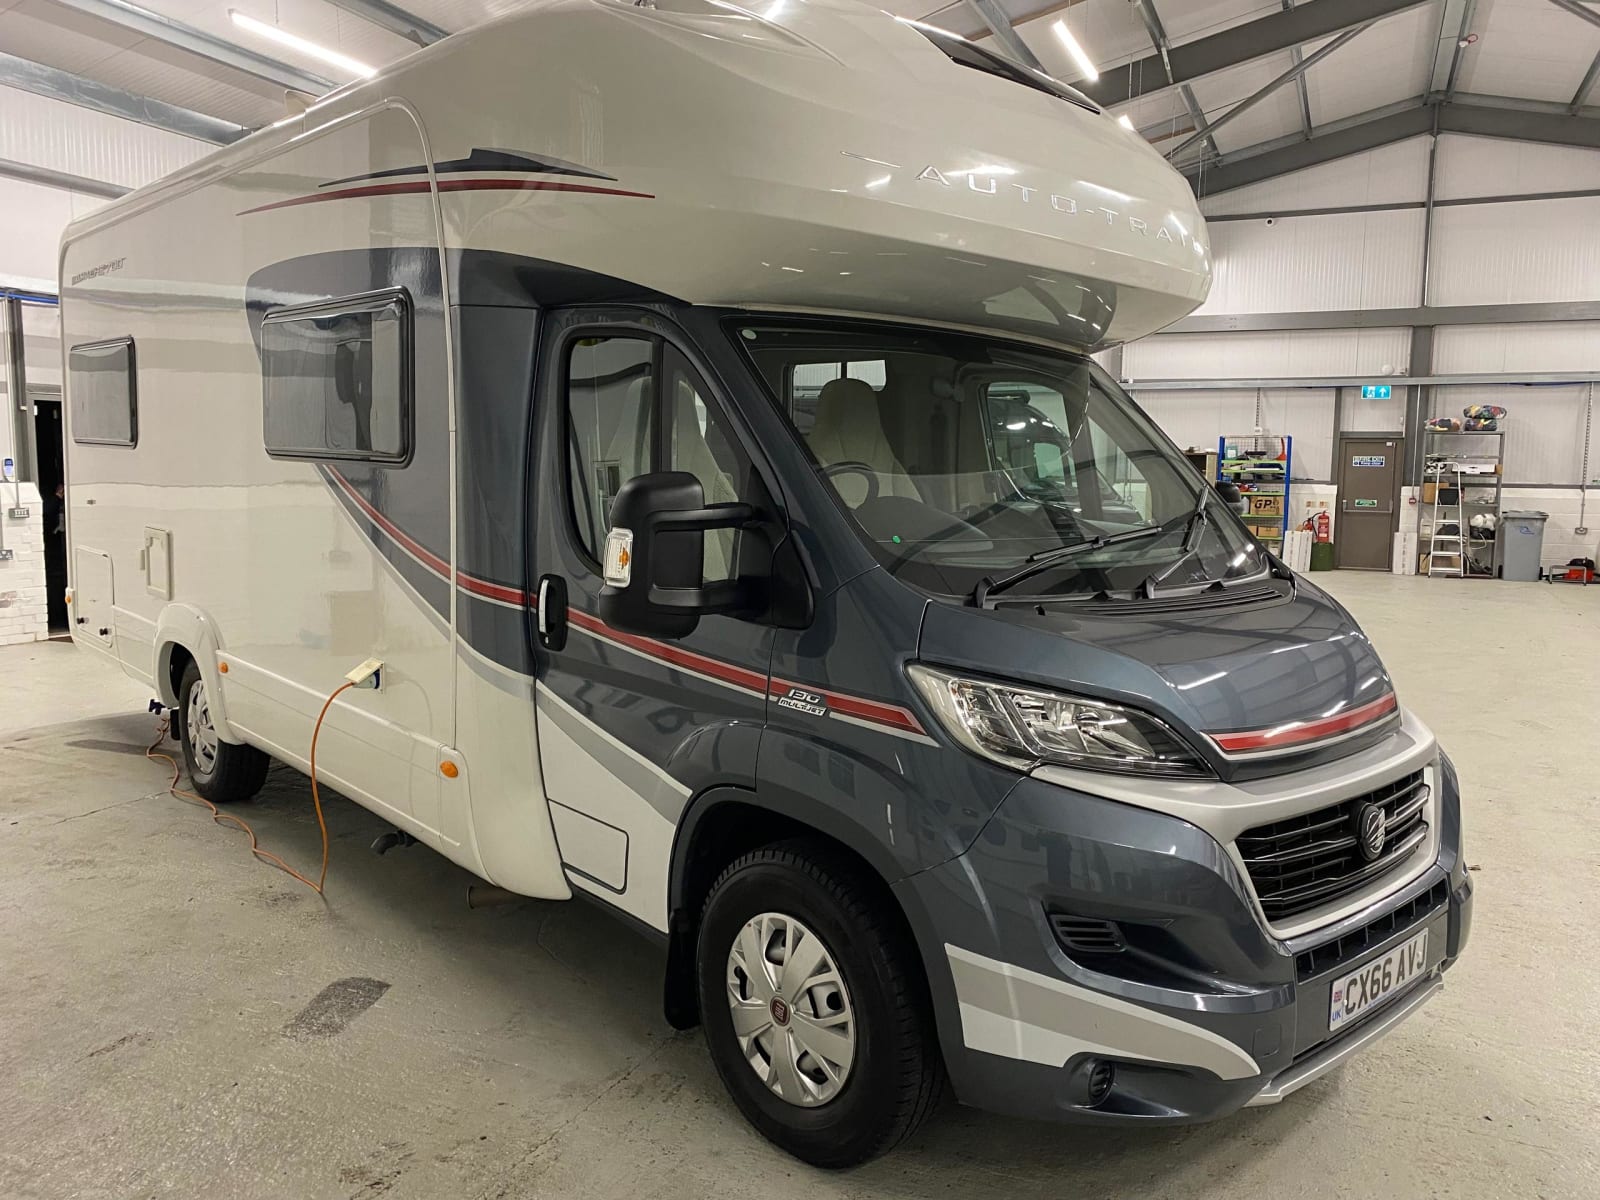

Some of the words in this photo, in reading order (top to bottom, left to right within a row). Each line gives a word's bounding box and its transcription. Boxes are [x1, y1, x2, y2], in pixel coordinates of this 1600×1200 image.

[1344, 957, 1393, 1015] CX66
[1396, 934, 1427, 985] AVJ
[1331, 1009, 1342, 1022] UK
